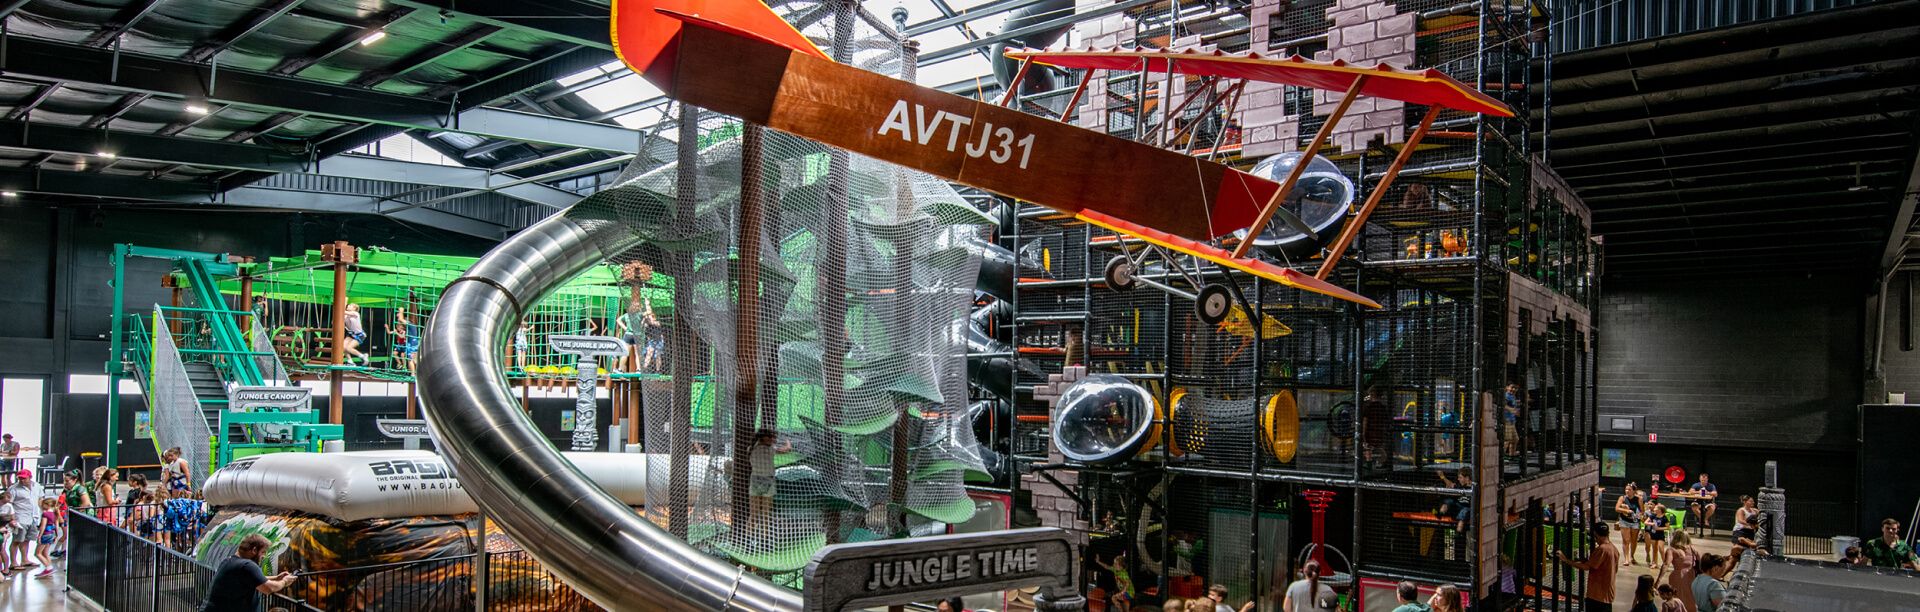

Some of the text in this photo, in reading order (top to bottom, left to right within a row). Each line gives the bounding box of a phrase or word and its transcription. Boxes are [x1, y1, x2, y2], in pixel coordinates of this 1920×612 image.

[877, 99, 1036, 170] AVTJ31
[377, 482, 461, 492] WWW.BAGJU
[867, 547, 1038, 591] JUNGLE TIME
